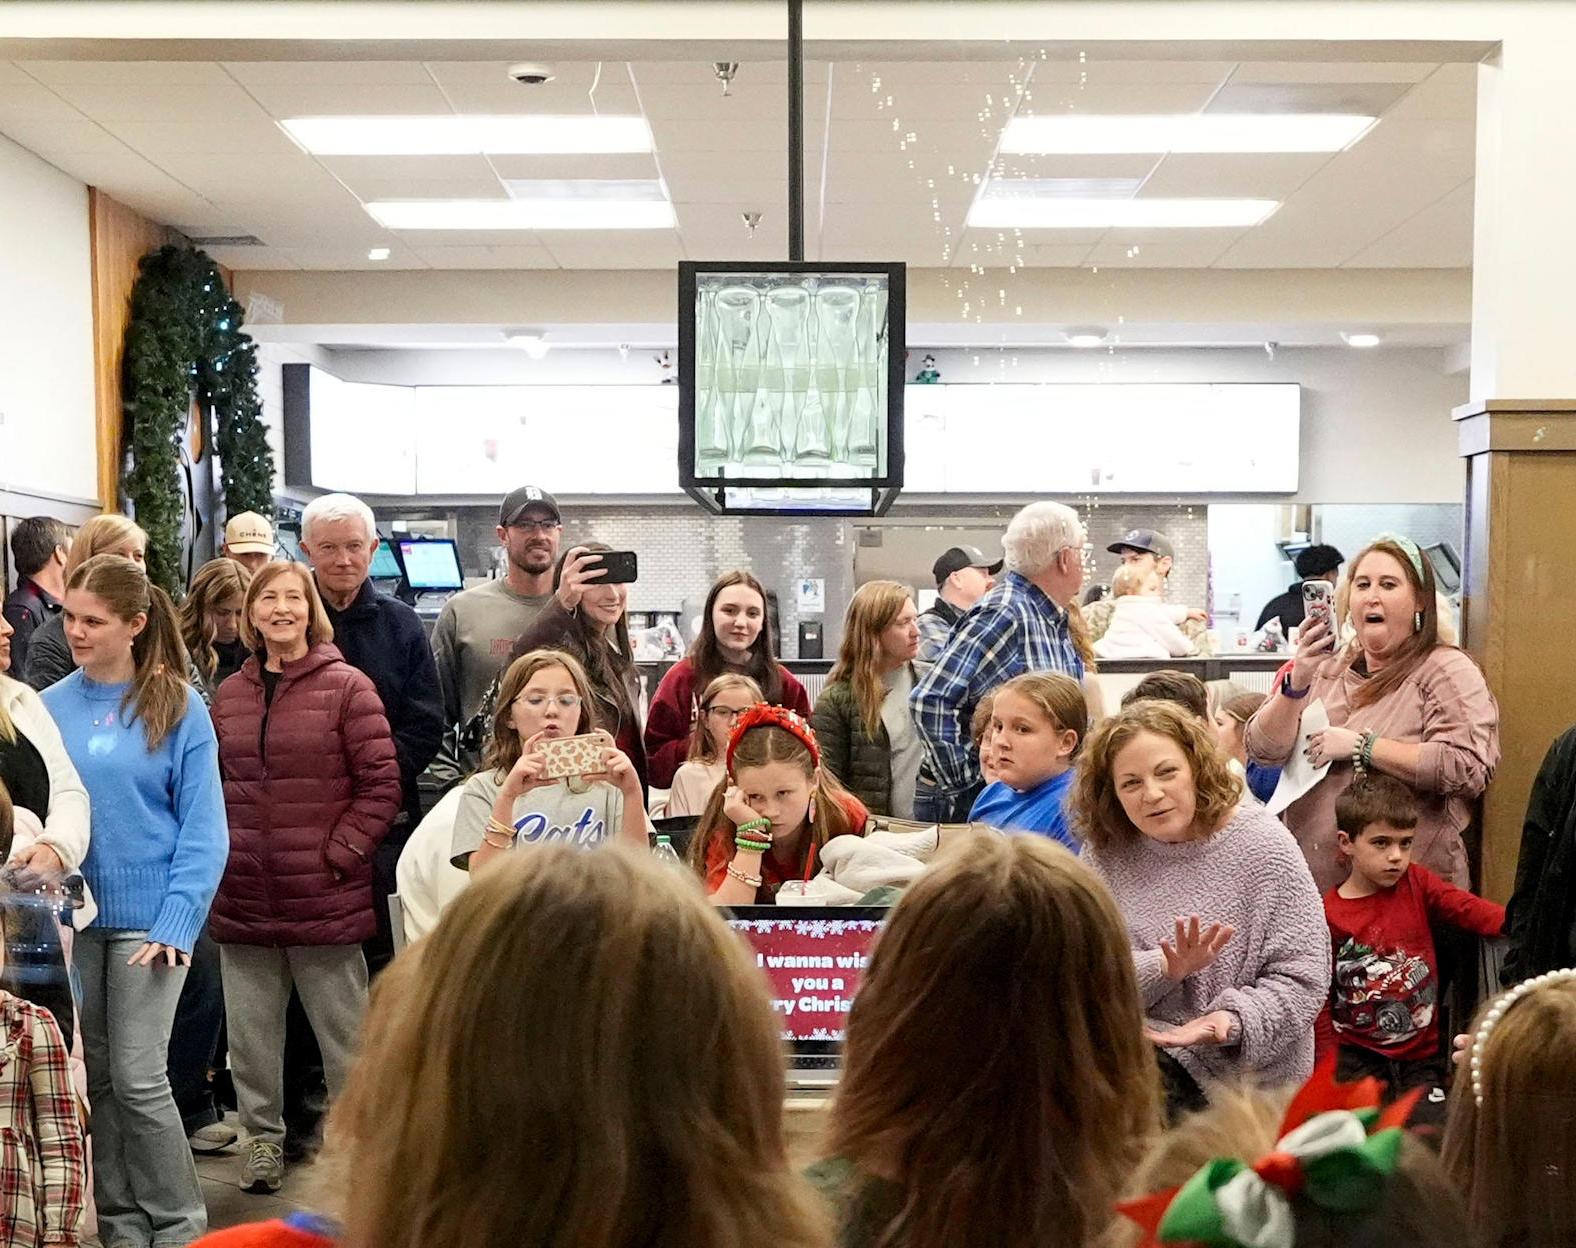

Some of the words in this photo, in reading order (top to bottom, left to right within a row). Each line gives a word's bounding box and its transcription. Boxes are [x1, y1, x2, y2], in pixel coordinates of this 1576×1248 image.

[766, 956, 834, 969] wanna
[836, 952, 871, 969] wis
[791, 978, 829, 994] you
[831, 978, 844, 991] a
[798, 995, 856, 1013] Chris
